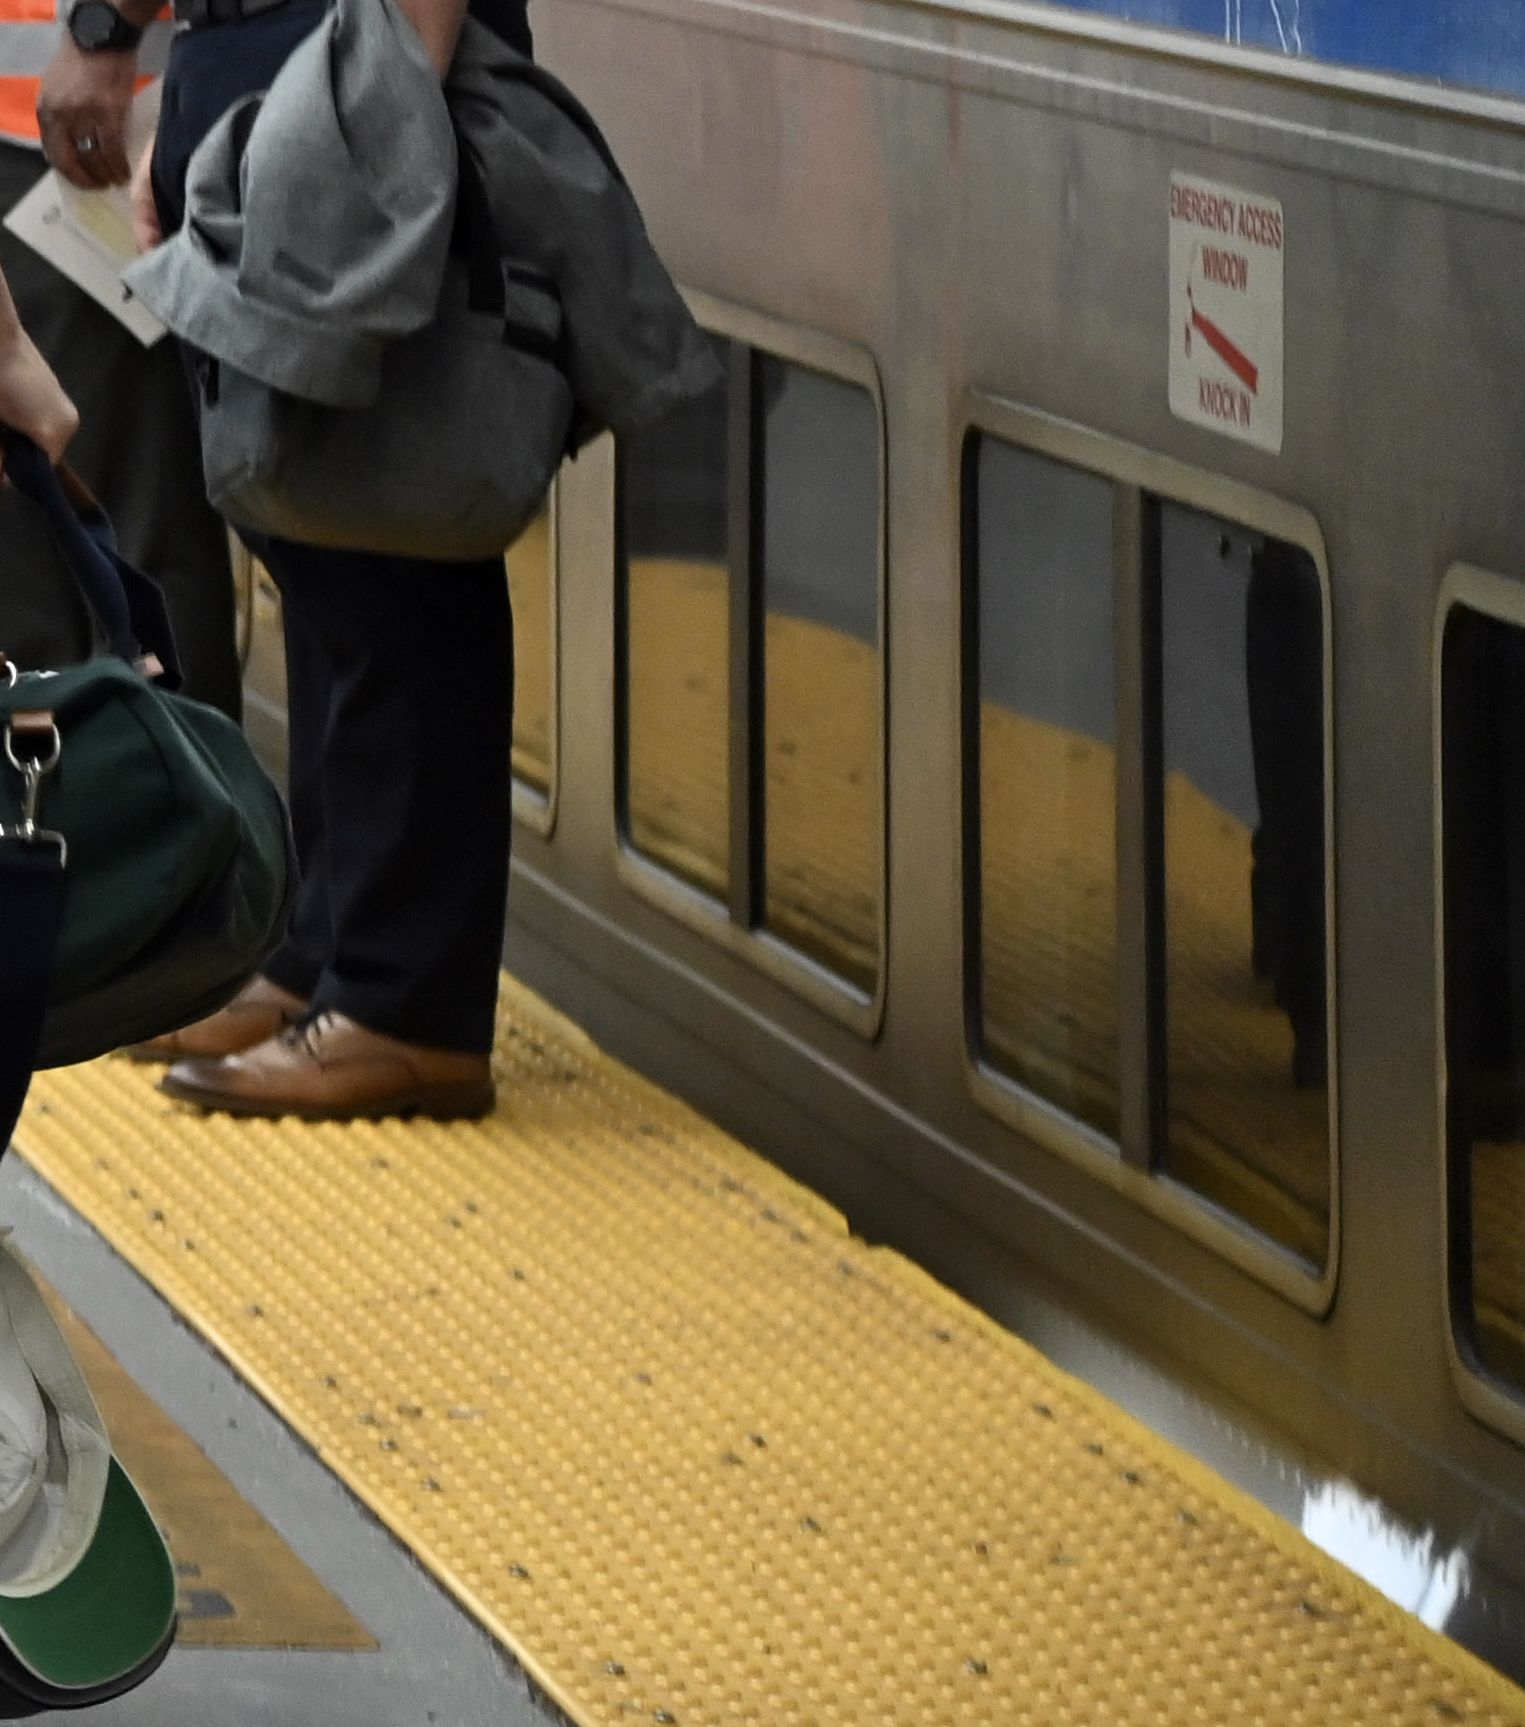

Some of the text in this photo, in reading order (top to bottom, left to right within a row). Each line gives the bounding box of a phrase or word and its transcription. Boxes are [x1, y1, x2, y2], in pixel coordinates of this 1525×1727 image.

[1171, 184, 1283, 250] EMERGENCY ACCESS
[1202, 245, 1249, 291] WINDOW
[1199, 377, 1238, 424] KNOCK
